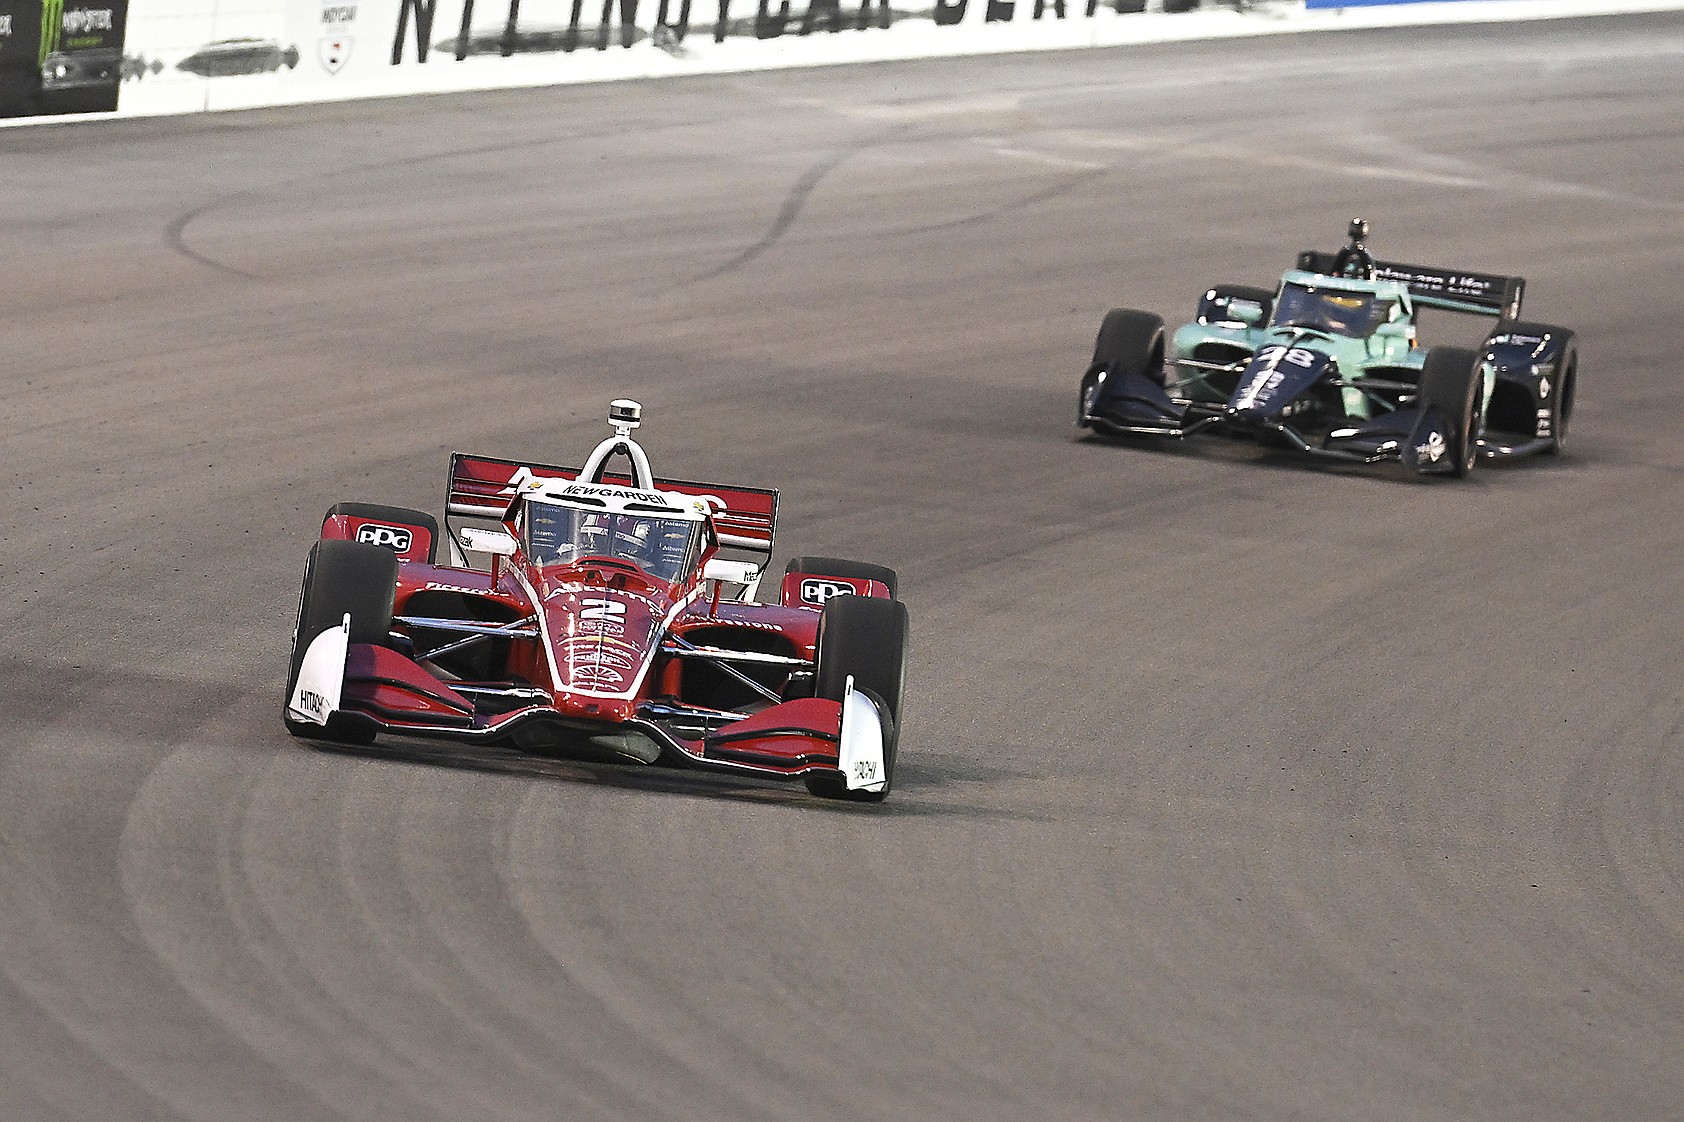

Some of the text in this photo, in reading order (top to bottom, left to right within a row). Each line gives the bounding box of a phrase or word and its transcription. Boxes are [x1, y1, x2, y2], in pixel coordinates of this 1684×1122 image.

[562, 484, 668, 506] NEWGARDEN
[359, 527, 409, 550] PPG
[579, 598, 627, 625] 2
